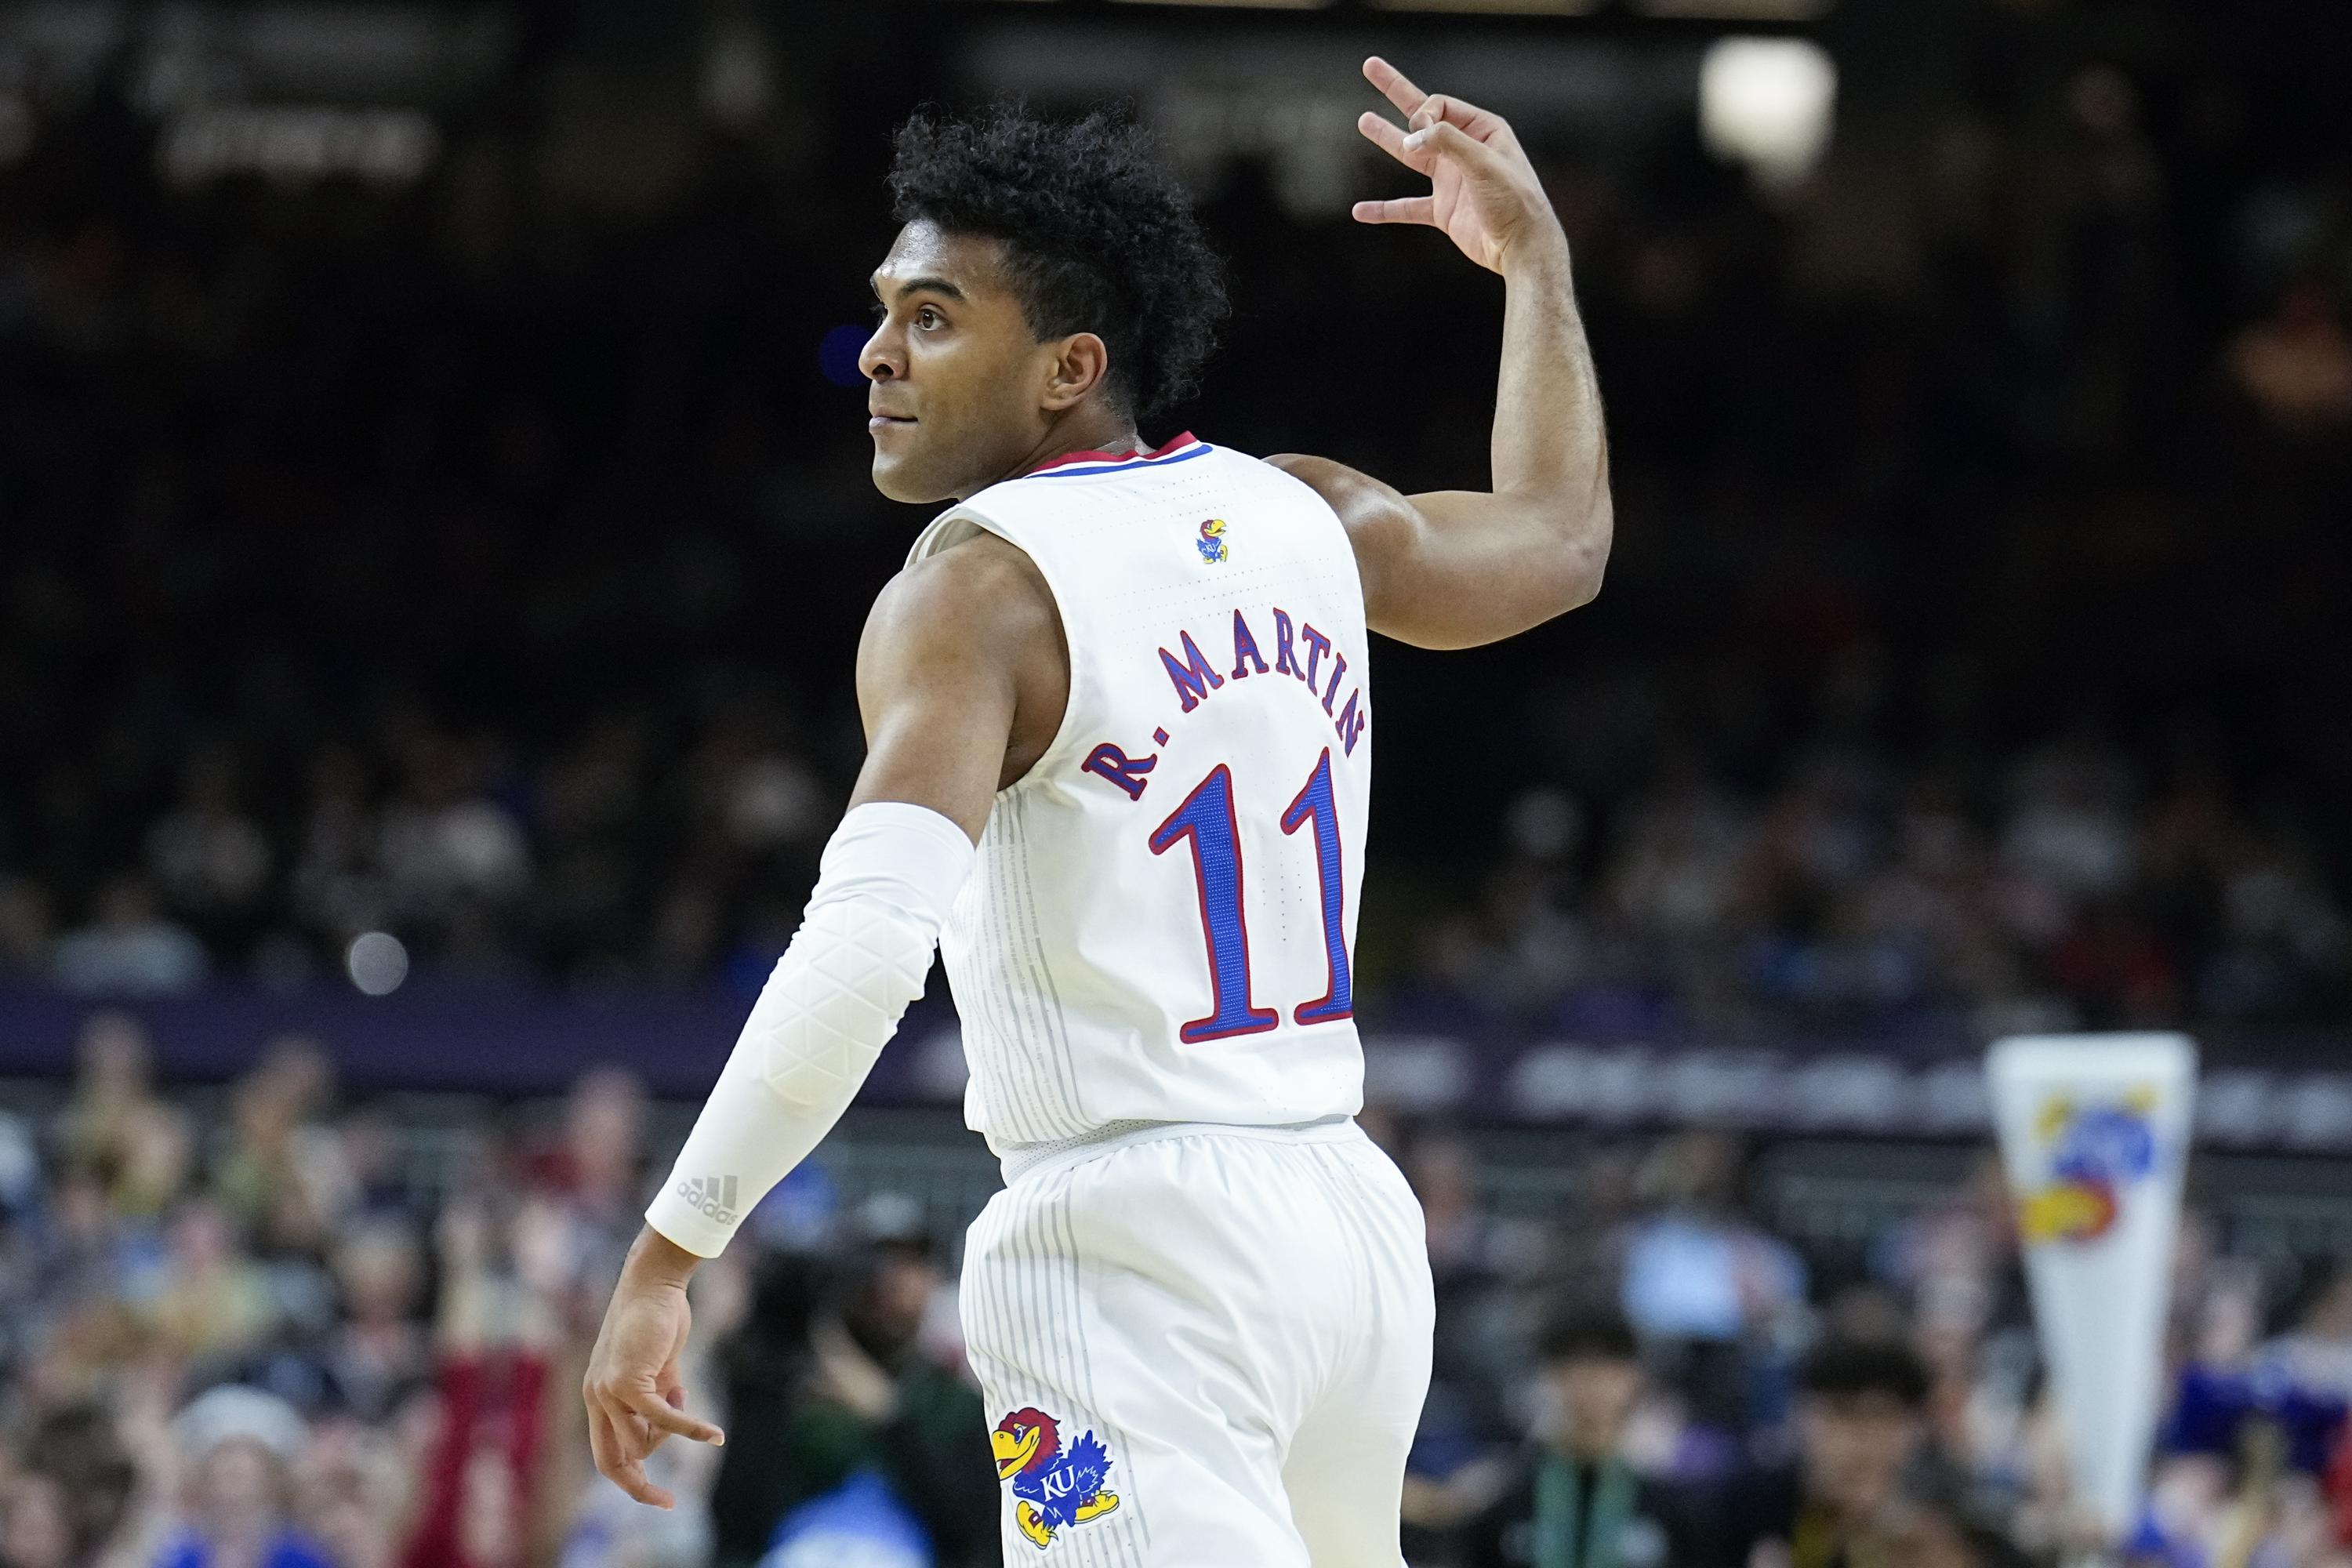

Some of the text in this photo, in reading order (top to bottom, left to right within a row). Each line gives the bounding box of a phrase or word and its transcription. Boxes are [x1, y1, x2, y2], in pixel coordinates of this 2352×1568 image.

[1081, 607, 1365, 801] R. MARTIN
[1149, 746, 1353, 1044] 11
[677, 1181, 739, 1225] adidas
[1040, 1465, 1076, 1502] KU
